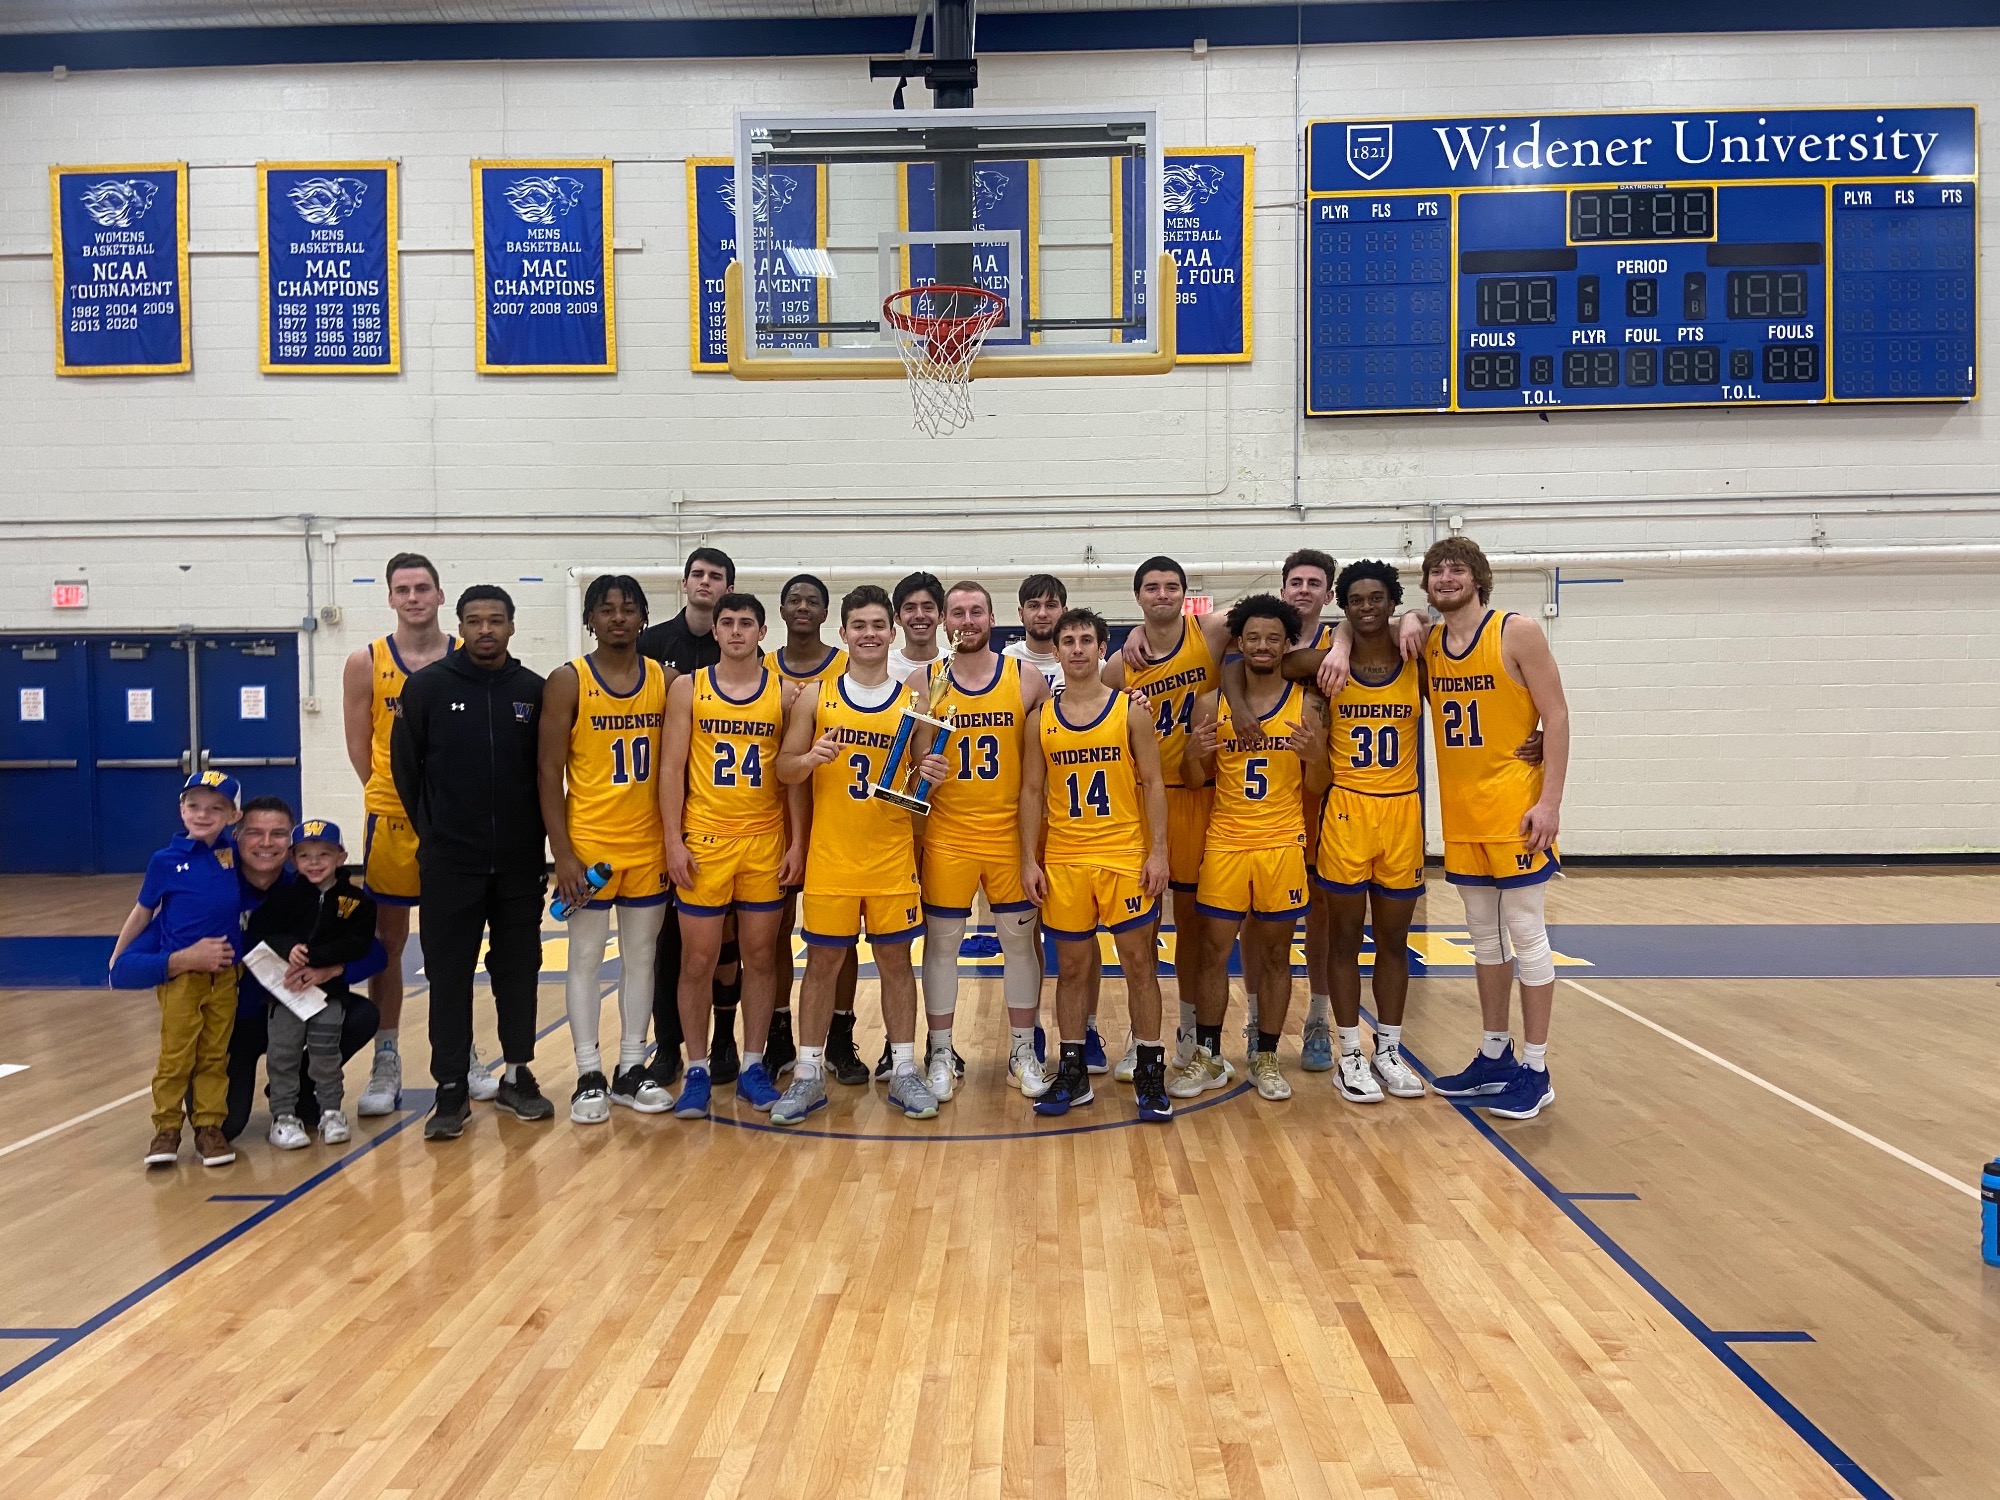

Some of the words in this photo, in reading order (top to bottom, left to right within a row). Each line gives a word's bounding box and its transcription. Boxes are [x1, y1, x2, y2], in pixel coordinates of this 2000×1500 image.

[1433, 120, 1653, 171] Widener
[1671, 115, 1939, 174] University
[1353, 148, 1386, 160] 1821
[1844, 190, 1872, 206] PLYR
[1895, 190, 1915, 204] FLS
[1941, 189, 1963, 204] PTS
[1321, 204, 1349, 220] PLYR
[1372, 203, 1391, 218] FLS
[1417, 202, 1438, 216] PTS
[1166, 217, 1200, 229] MENS
[95, 231, 145, 244] WOMENS
[310, 229, 344, 241] MENS
[527, 228, 561, 240] MENS
[82, 243, 155, 257] BASKETBALL
[290, 242, 365, 255] BASKETBALL
[506, 241, 582, 253] BASKETBALL
[92, 261, 148, 281] NCAA
[305, 260, 351, 279] MAC
[522, 259, 567, 278] MAC
[1616, 259, 1668, 274] PERIOD
[1189, 268, 1235, 284] FOUR
[70, 281, 173, 299] TOURNAMENT
[277, 280, 379, 297] CHAMPIONS
[494, 280, 595, 296] CHAMPIONS
[72, 305, 100, 318] 1982
[105, 304, 138, 316] 2004
[143, 302, 174, 315] 2009
[278, 303, 307, 316] 1962
[315, 303, 344, 316] 1972
[352, 303, 380, 316] 1976
[493, 302, 525, 315] 2007
[530, 302, 562, 315] 2008
[566, 302, 598, 315] 2009
[781, 300, 810, 312] 1976
[70, 320, 100, 332] 2013
[106, 318, 138, 330] 2020
[278, 317, 307, 330] 1977
[315, 317, 344, 330] 1978
[352, 317, 381, 330] 1982
[278, 331, 307, 343] 1983
[315, 331, 345, 343] 1985
[352, 331, 382, 343] 1987
[1470, 332, 1516, 347] FOULS
[1572, 330, 1606, 344] PLYR
[1625, 328, 1662, 343] FOUL
[1677, 327, 1704, 341] PTS
[1768, 325, 1814, 339] FOULS
[279, 345, 308, 357] 1997
[314, 345, 347, 357] 2000
[352, 345, 383, 357] 2001
[1522, 390, 1561, 404] T.O.L.
[1721, 385, 1761, 399] T.O.L.
[56, 585, 80, 606] EXIT
[1432, 674, 1496, 692] WIDENER
[1154, 690, 1195, 737] 44
[1338, 703, 1412, 719] WIDENER
[590, 713, 662, 731] WIDENER
[698, 718, 776, 737] WIDENER
[1442, 698, 1484, 748] 21
[1350, 724, 1400, 769] 30
[610, 735, 651, 785] 10
[713, 740, 762, 788] 24
[956, 734, 999, 781] 13
[1050, 746, 1121, 766] WIDENER
[848, 752, 871, 802] 3
[1243, 756, 1269, 801] 5
[1065, 769, 1111, 818] 14
